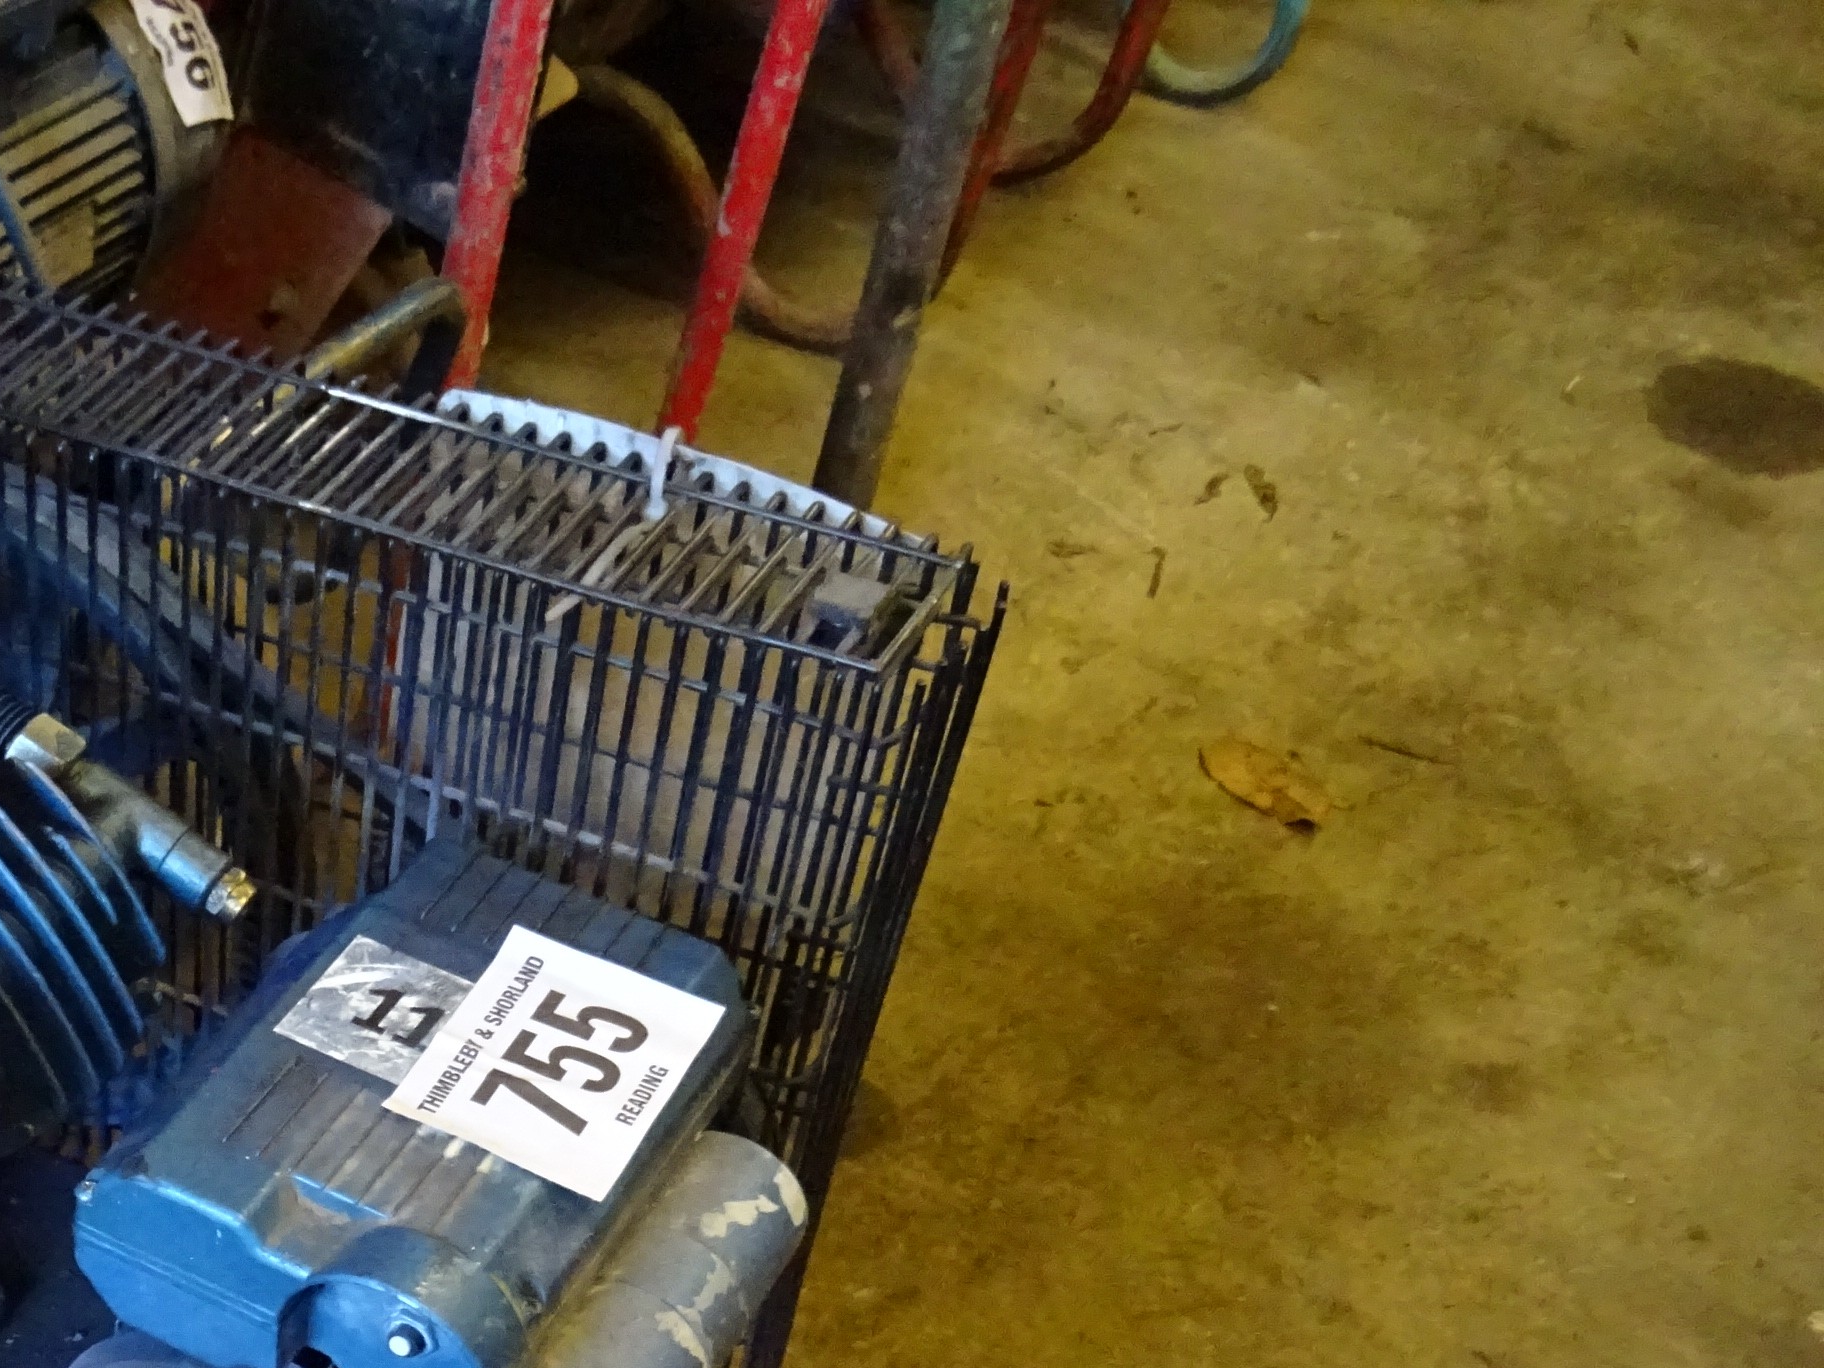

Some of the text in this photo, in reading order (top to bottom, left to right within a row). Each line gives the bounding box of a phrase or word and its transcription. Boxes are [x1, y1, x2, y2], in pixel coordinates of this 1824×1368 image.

[418, 956, 544, 1114] THIMBLEBY & SHORLAND
[470, 990, 649, 1136] 755
[616, 1064, 669, 1126] READING
